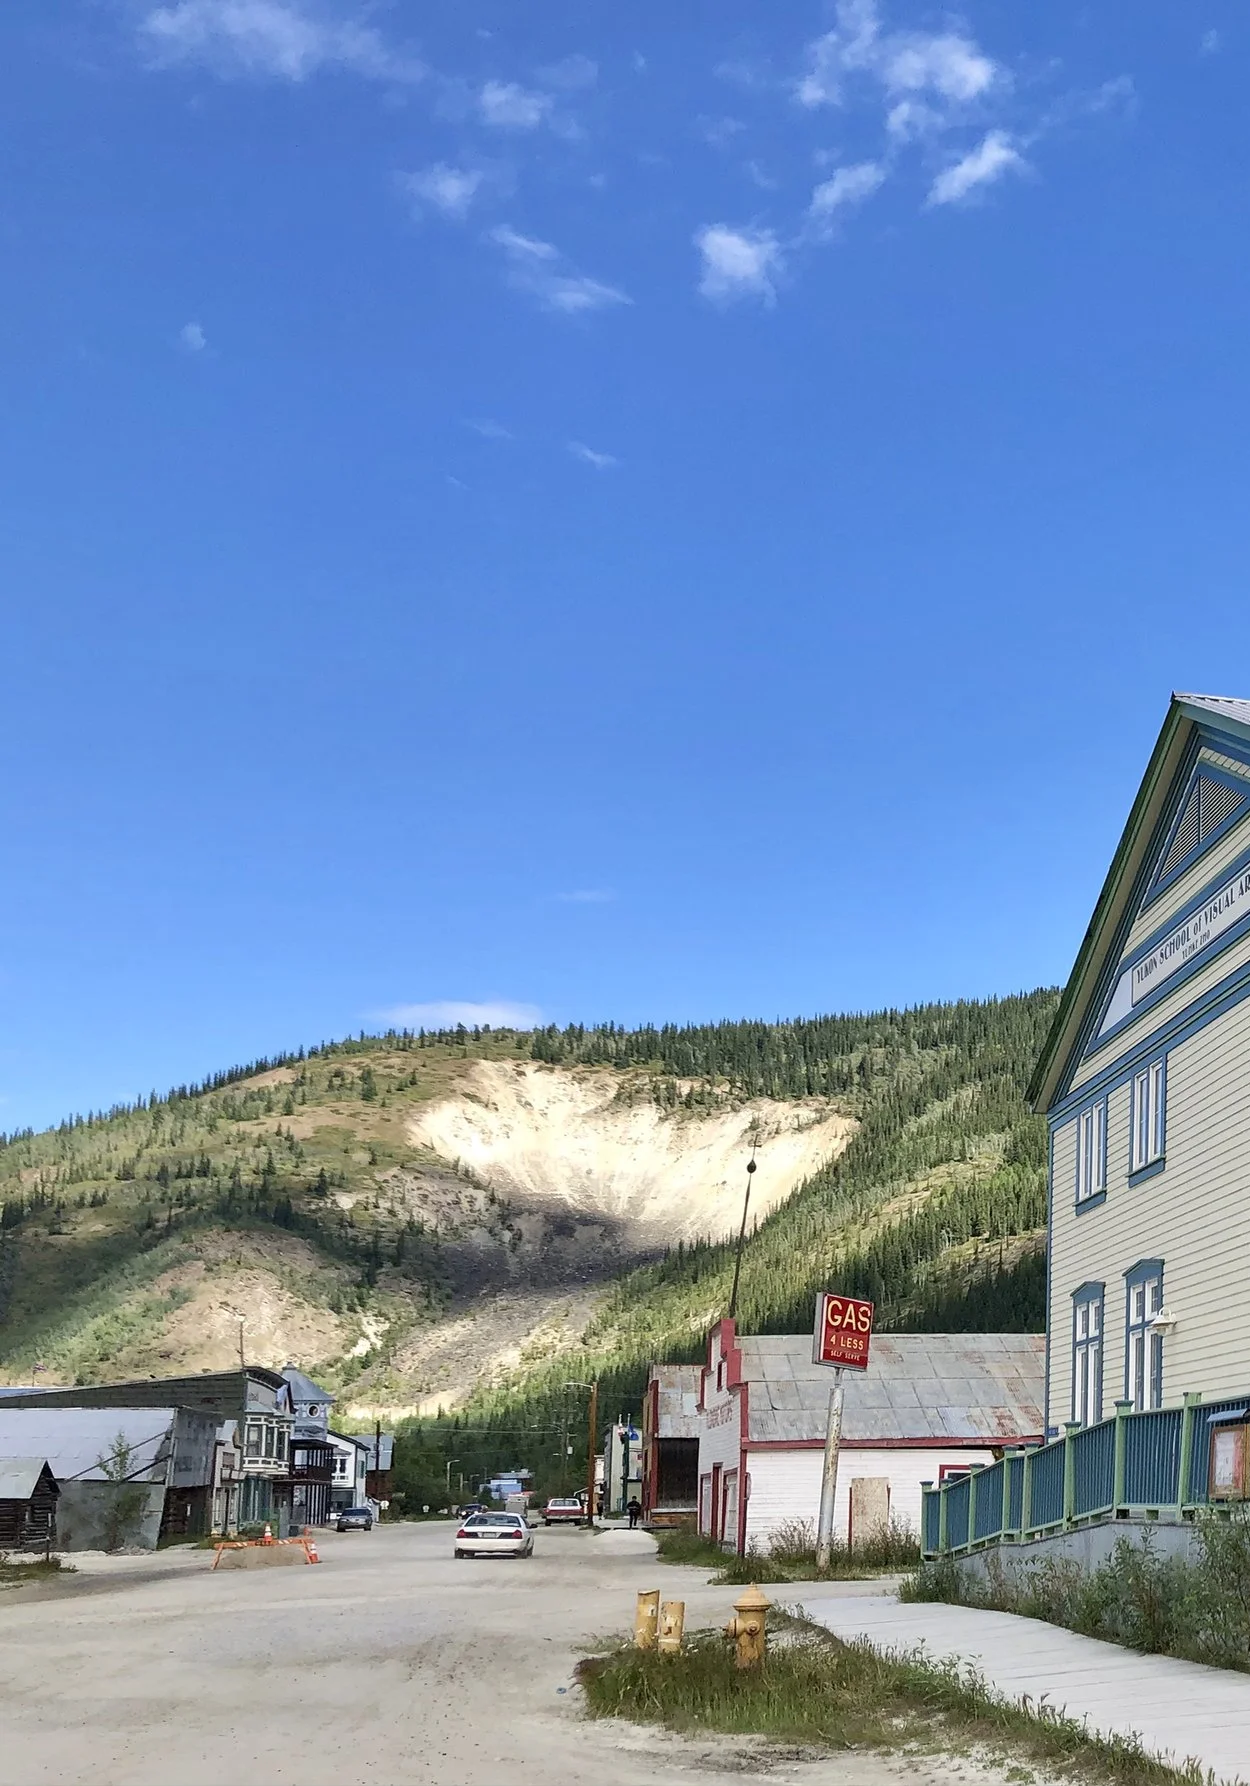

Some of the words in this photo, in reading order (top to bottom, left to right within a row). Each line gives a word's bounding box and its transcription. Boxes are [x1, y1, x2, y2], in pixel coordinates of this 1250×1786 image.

[1136, 955, 1158, 984] YUKON
[1159, 926, 1191, 965] SCHOOL
[1193, 915, 1203, 936] of
[1204, 889, 1236, 926] VISUAL
[827, 1299, 871, 1332] GAS
[830, 1334, 837, 1345] 4
[840, 1335, 864, 1350] LESS
[830, 1350, 843, 1358] SELF
[844, 1352, 861, 1361] SERVE
